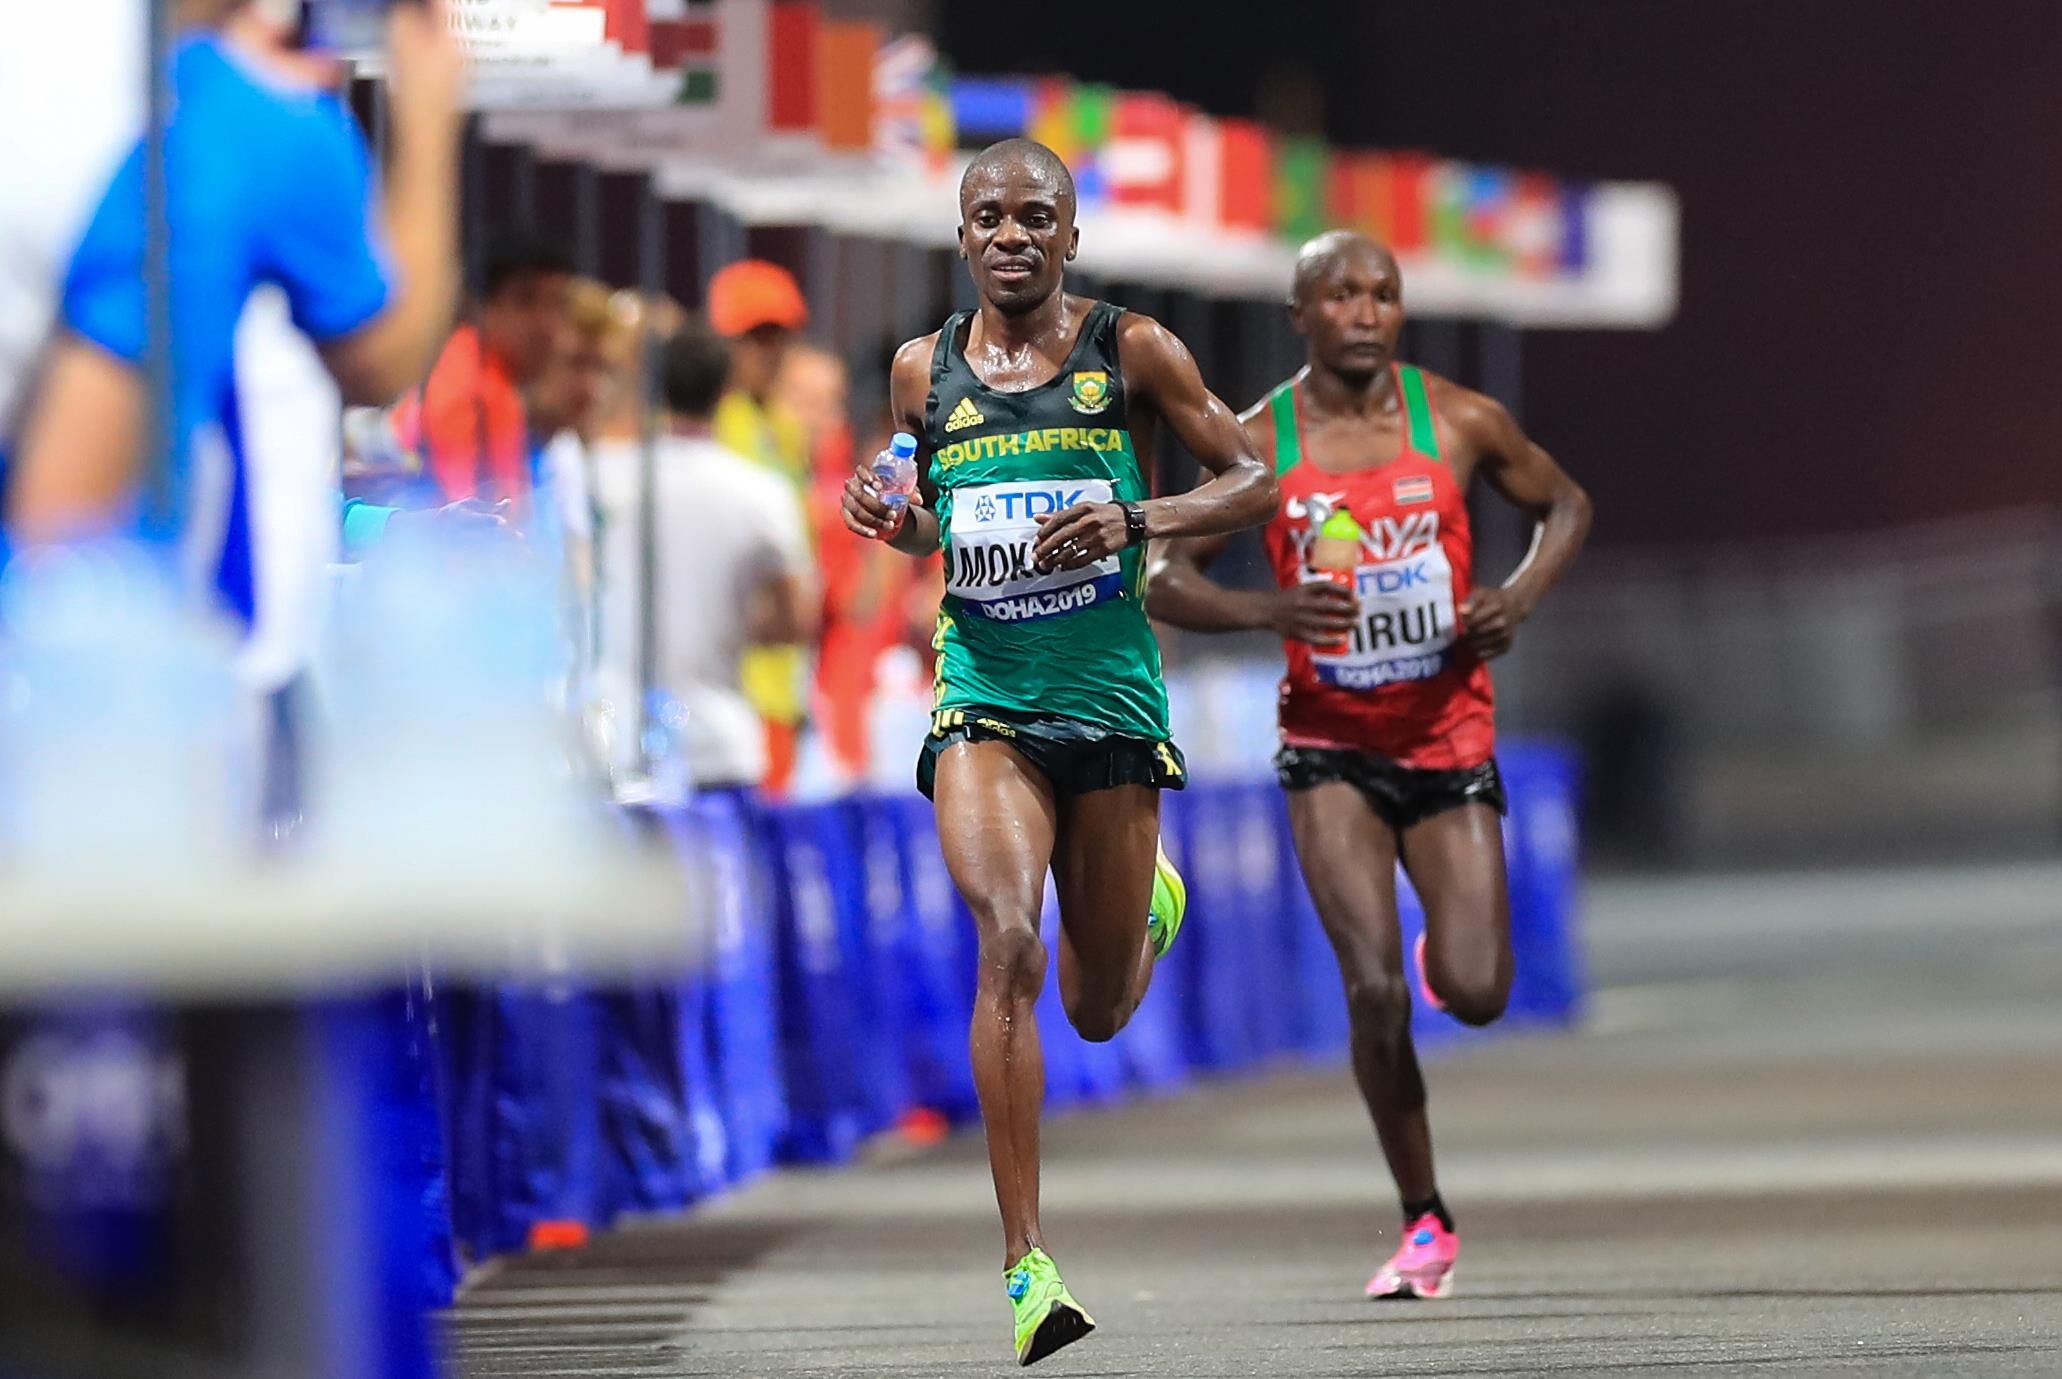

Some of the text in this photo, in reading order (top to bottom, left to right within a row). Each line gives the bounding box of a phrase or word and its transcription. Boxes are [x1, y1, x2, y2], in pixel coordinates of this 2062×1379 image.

[945, 414, 985, 433] adidas
[937, 427, 1122, 471] SOUTH AFRICA
[996, 489, 1084, 519] TDK
[1356, 562, 1429, 594] TDK
[1352, 602, 1440, 653] IRUI
